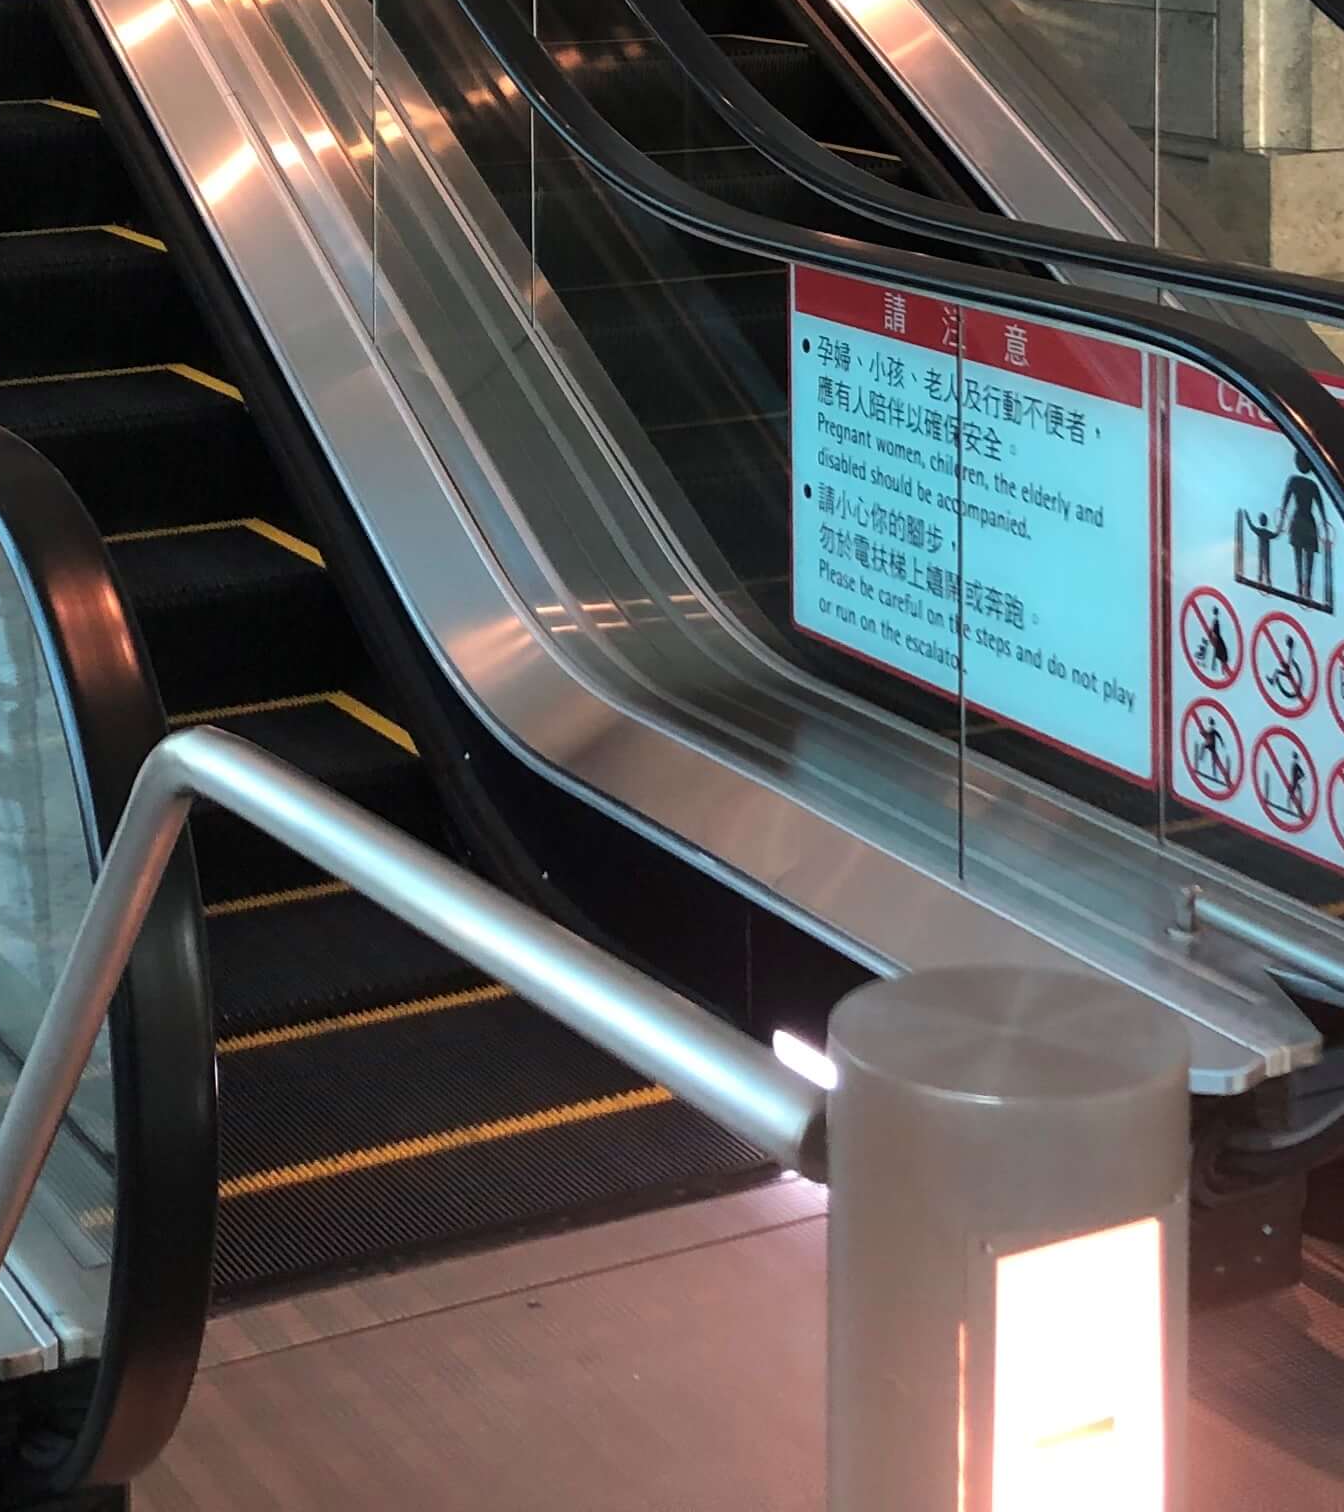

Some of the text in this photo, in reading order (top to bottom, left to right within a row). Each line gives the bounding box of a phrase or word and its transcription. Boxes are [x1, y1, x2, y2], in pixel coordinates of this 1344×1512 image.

[818, 412, 872, 448] Pregnant
[876, 437, 926, 469] women,
[994, 472, 1017, 499] the
[1021, 482, 1071, 521] elderly
[1075, 503, 1104, 528] and
[818, 447, 866, 480] disabled
[870, 466, 912, 497] should
[917, 481, 932, 505] be
[819, 558, 856, 592] Please
[859, 576, 874, 601] be
[878, 588, 922, 619] careful
[927, 608, 945, 627] on
[975, 626, 1012, 658] steps
[1016, 645, 1042, 670] and
[1047, 652, 1067, 679] do
[1071, 667, 1098, 693] not
[1103, 676, 1136, 713] play
[819, 597, 968, 675] or run on the escalato.
